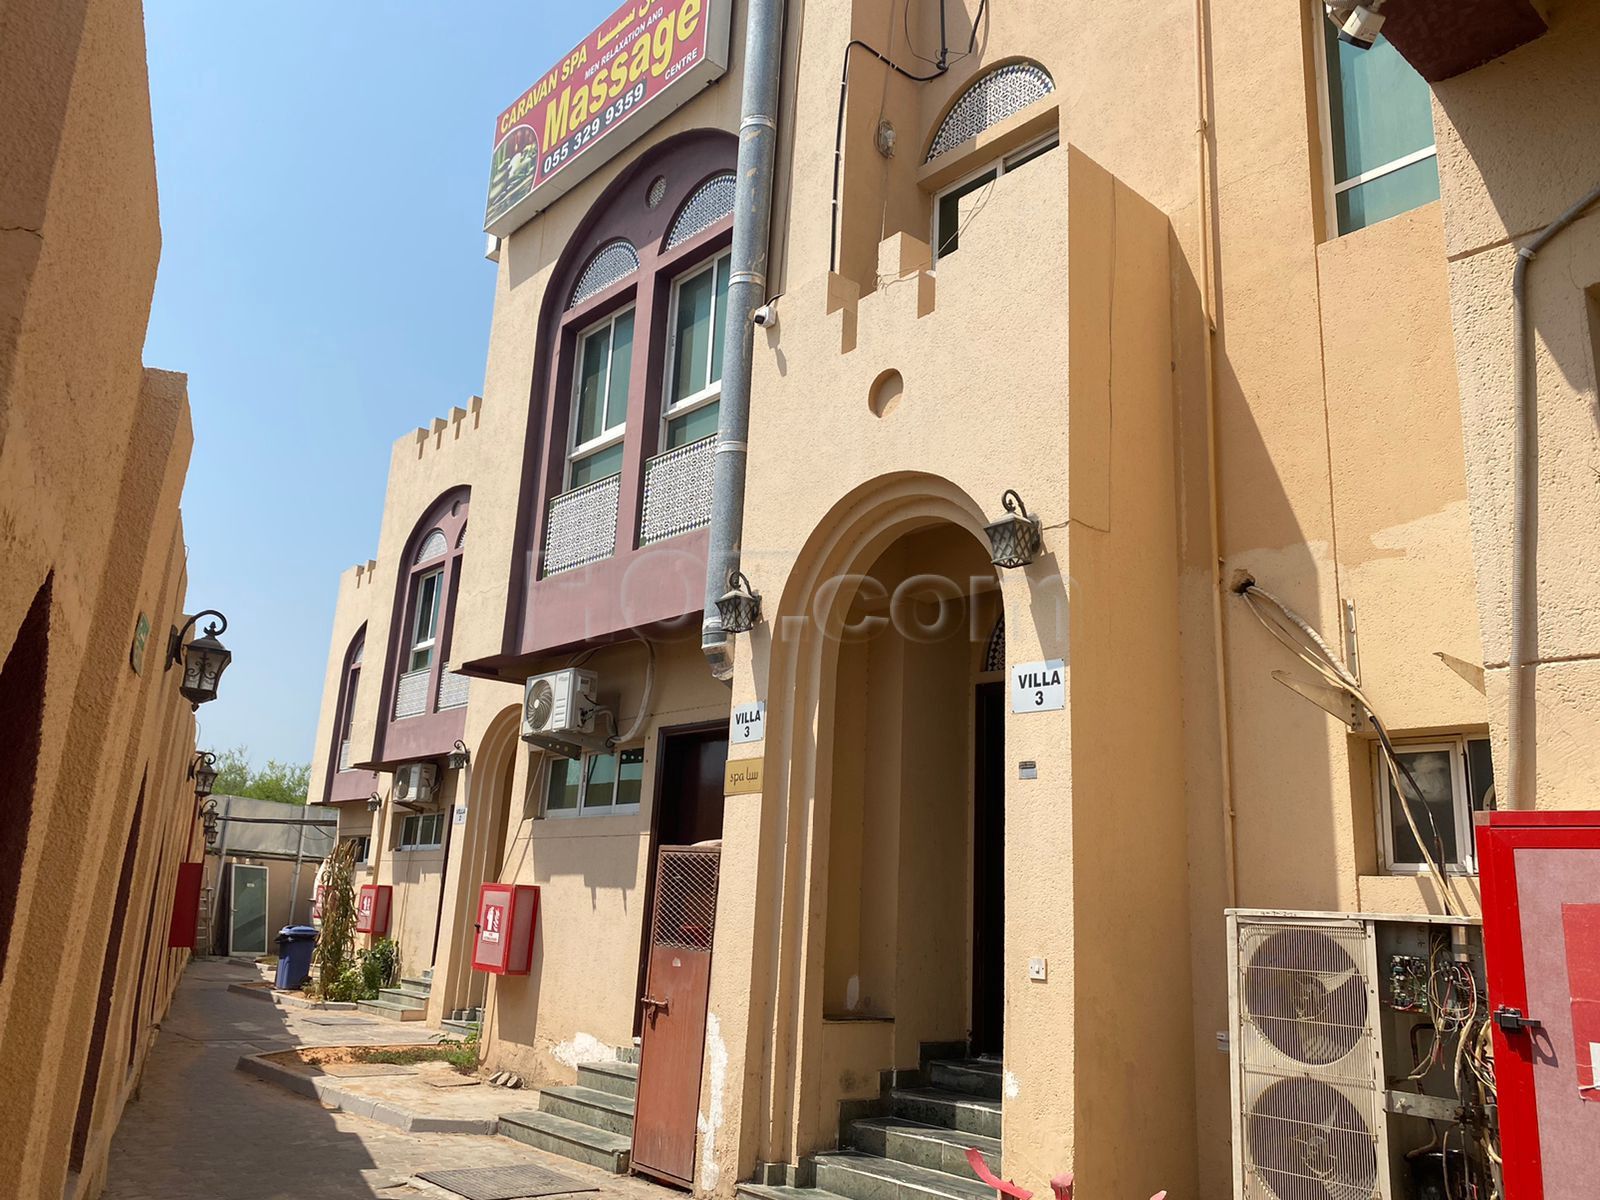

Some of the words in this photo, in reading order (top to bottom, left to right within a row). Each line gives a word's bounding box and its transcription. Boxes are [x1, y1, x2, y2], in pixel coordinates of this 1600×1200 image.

[584, 61, 600, 80] MEN
[601, 22, 646, 66] RELAXATION
[646, 7, 664, 29] AND
[664, 47, 698, 81] CENTRE
[500, 71, 558, 134] CARAVAN
[561, 46, 587, 82] SPA
[541, 0, 701, 156] Massage
[543, 145, 569, 173] 055
[573, 119, 600, 150] 329
[605, 82, 644, 125] 9359
[1017, 670, 1061, 689] VILLA
[1034, 690, 1044, 706] 3
[735, 709, 761, 725] VILLA
[743, 726, 750, 738] 3
[729, 771, 744, 786] spa
